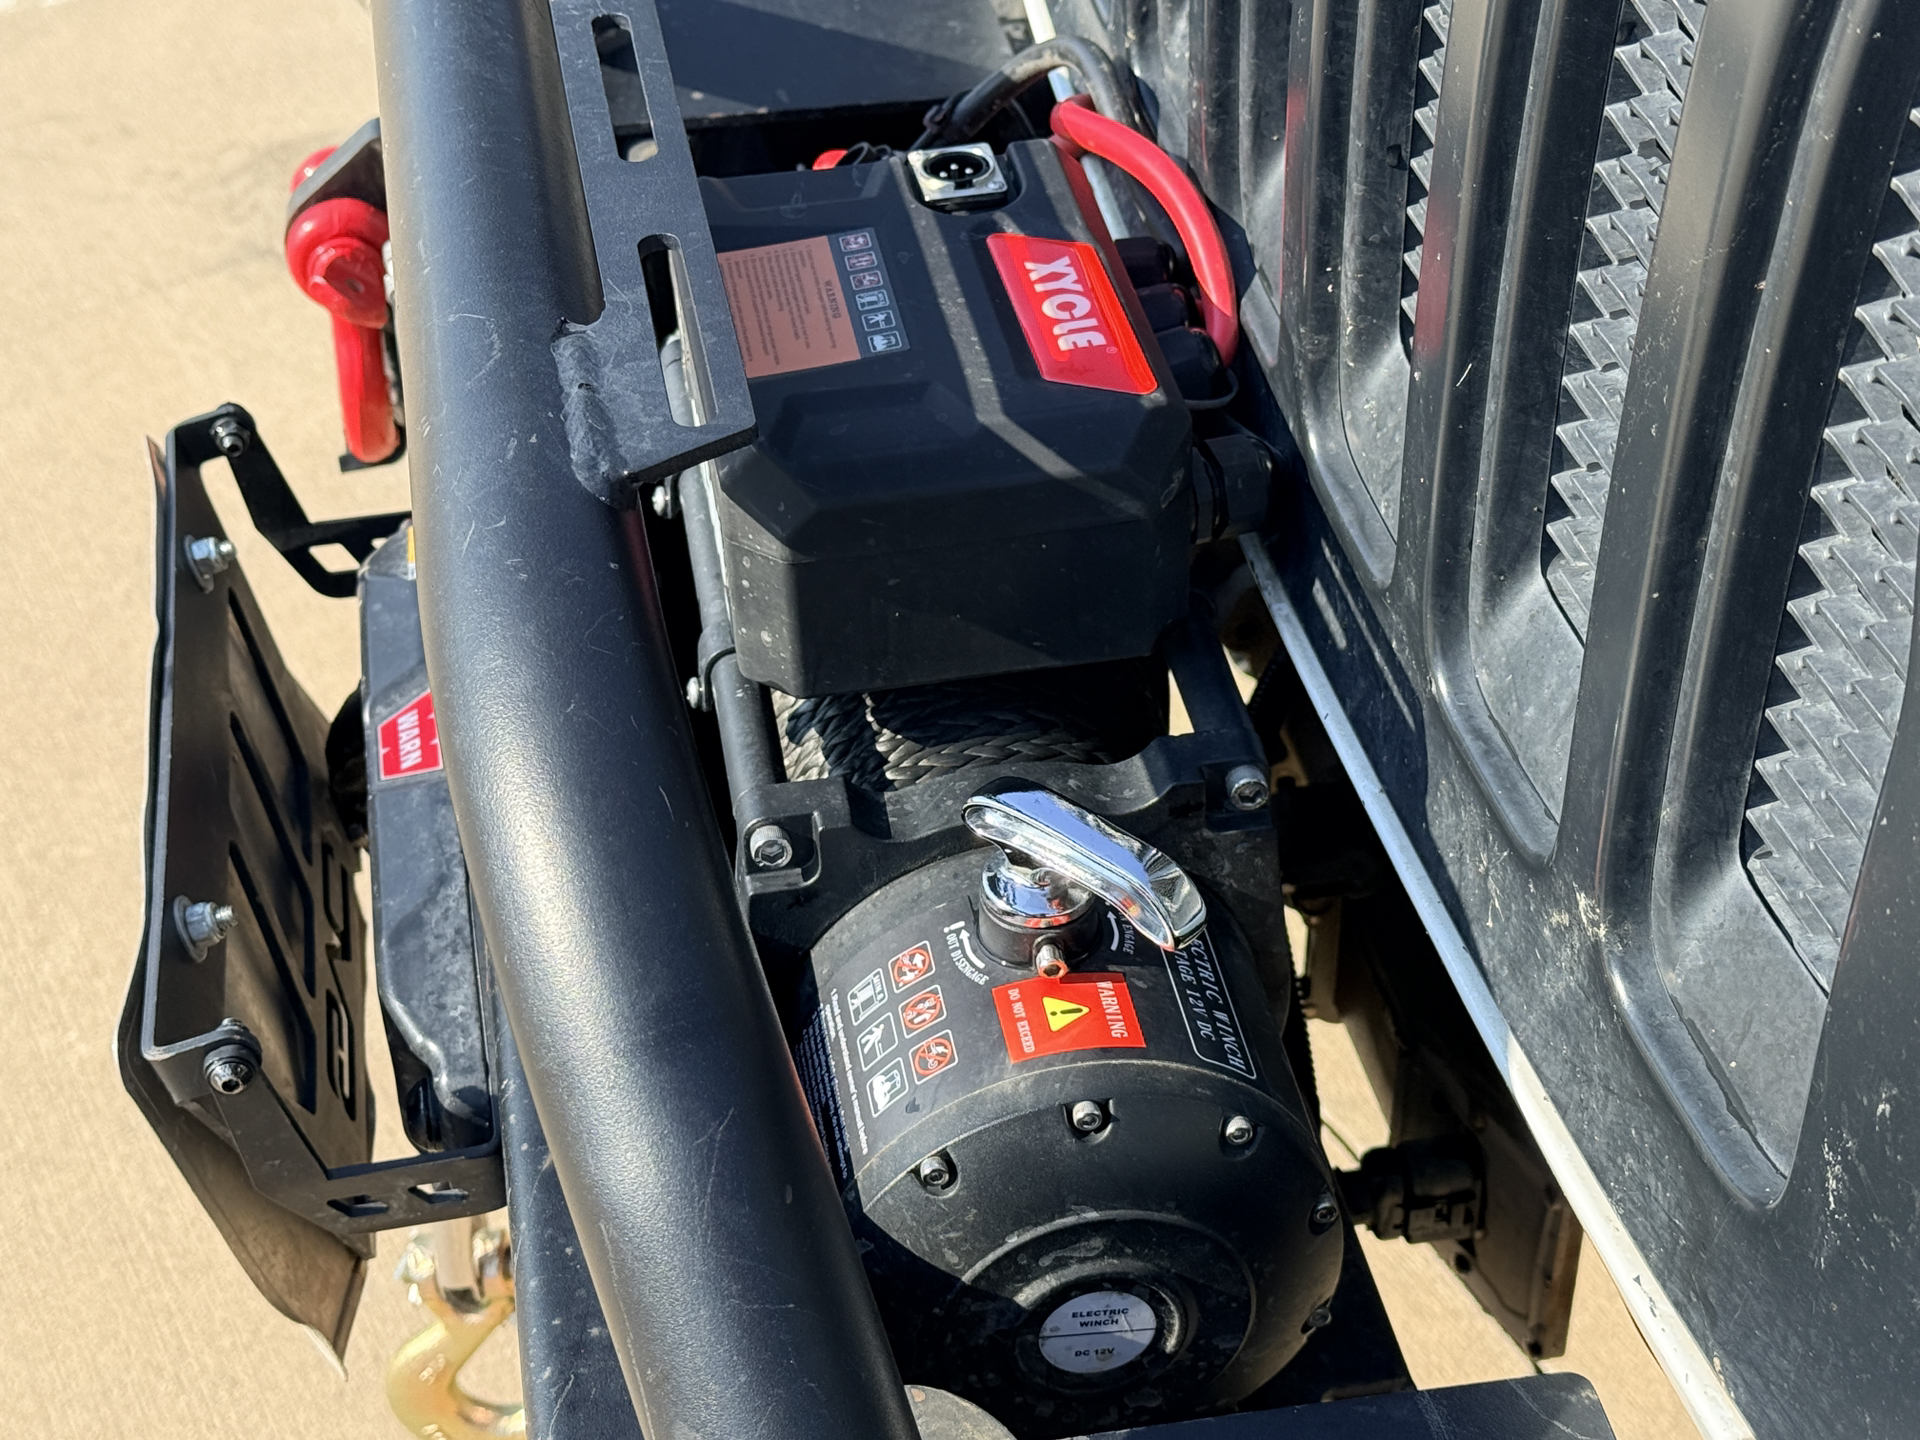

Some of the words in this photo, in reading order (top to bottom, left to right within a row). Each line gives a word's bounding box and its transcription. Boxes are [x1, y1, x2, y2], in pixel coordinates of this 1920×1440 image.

[824, 279, 842, 320] WARNING
[397, 708, 423, 771] WARN
[945, 932, 960, 950] OUT
[1122, 923, 1136, 956] ENGAGE
[950, 949, 990, 986] DISENGAGE
[1174, 949, 1198, 986] TAGE
[1007, 987, 1021, 1001] DO
[1096, 980, 1129, 1039] WARNING
[1186, 988, 1209, 1018] 12V
[1190, 938, 1224, 1005] ECTRIC
[1212, 1009, 1247, 1071] WINCH
[1011, 1001, 1027, 1019] NOT
[1016, 1020, 1036, 1054] EXCEED
[1196, 1019, 1216, 1041] DC
[1071, 1307, 1130, 1319] ELECTRIC
[1079, 1318, 1119, 1328] WINCH
[1074, 1349, 1090, 1357] DC
[1092, 1347, 1115, 1357] 12V
